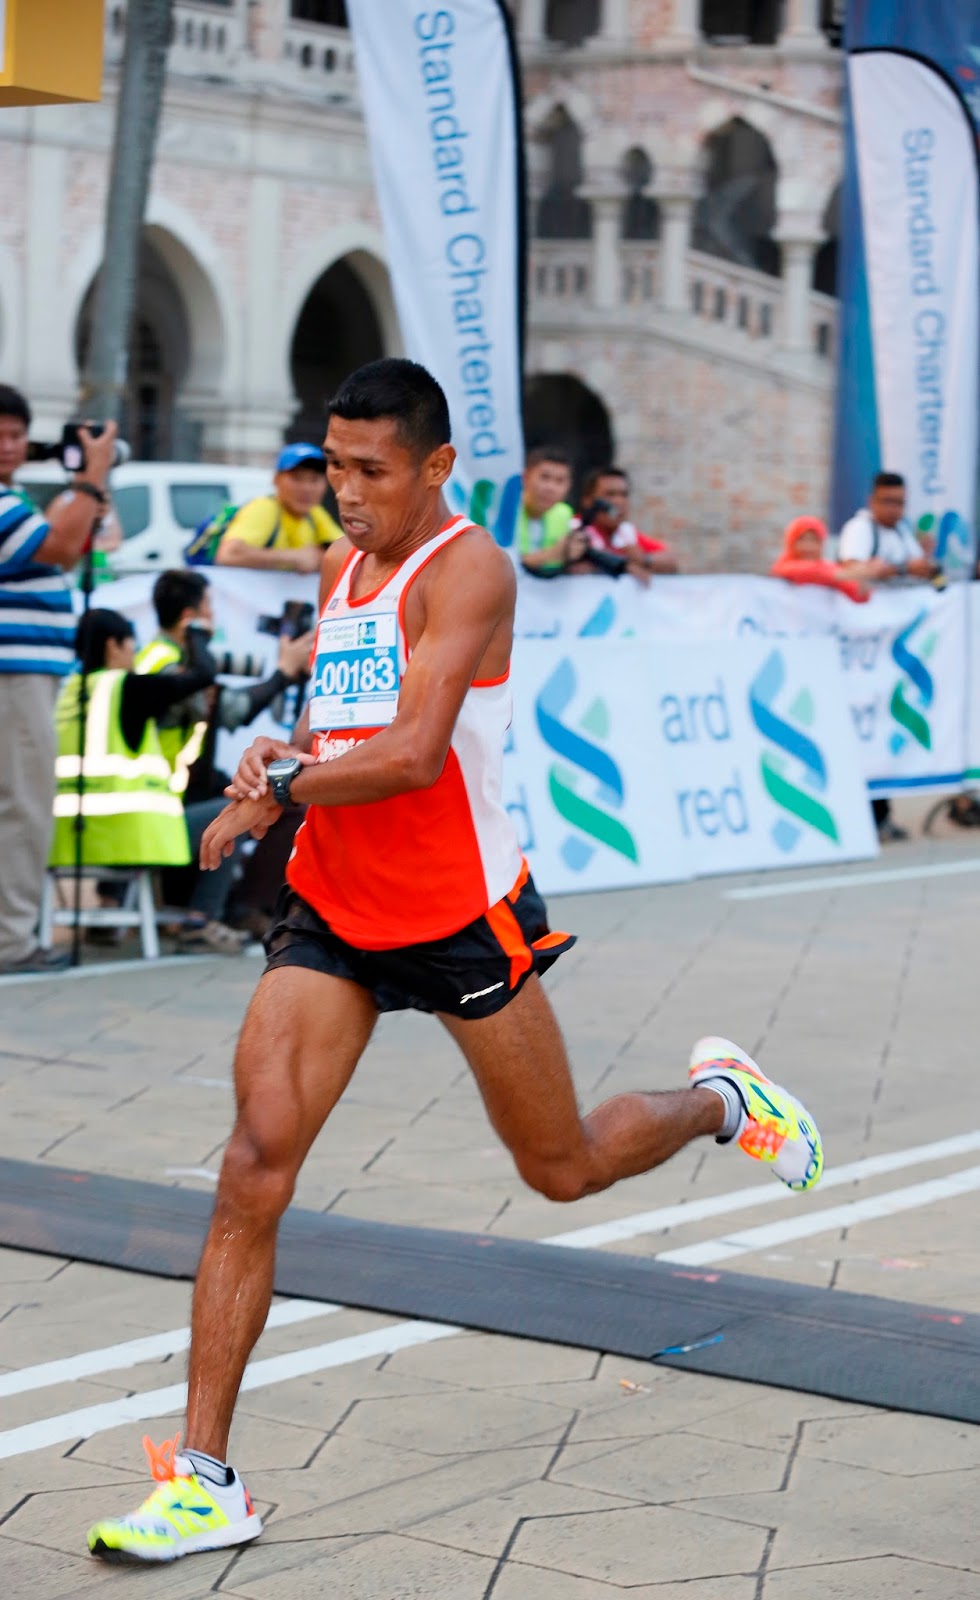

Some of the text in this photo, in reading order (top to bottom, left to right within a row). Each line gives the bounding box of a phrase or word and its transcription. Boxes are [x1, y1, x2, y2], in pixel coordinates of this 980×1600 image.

[414, 9, 508, 460] Standard Chartered
[902, 127, 947, 497] Standard Chartered
[660, 675, 731, 743] ard
[677, 767, 749, 838] red
